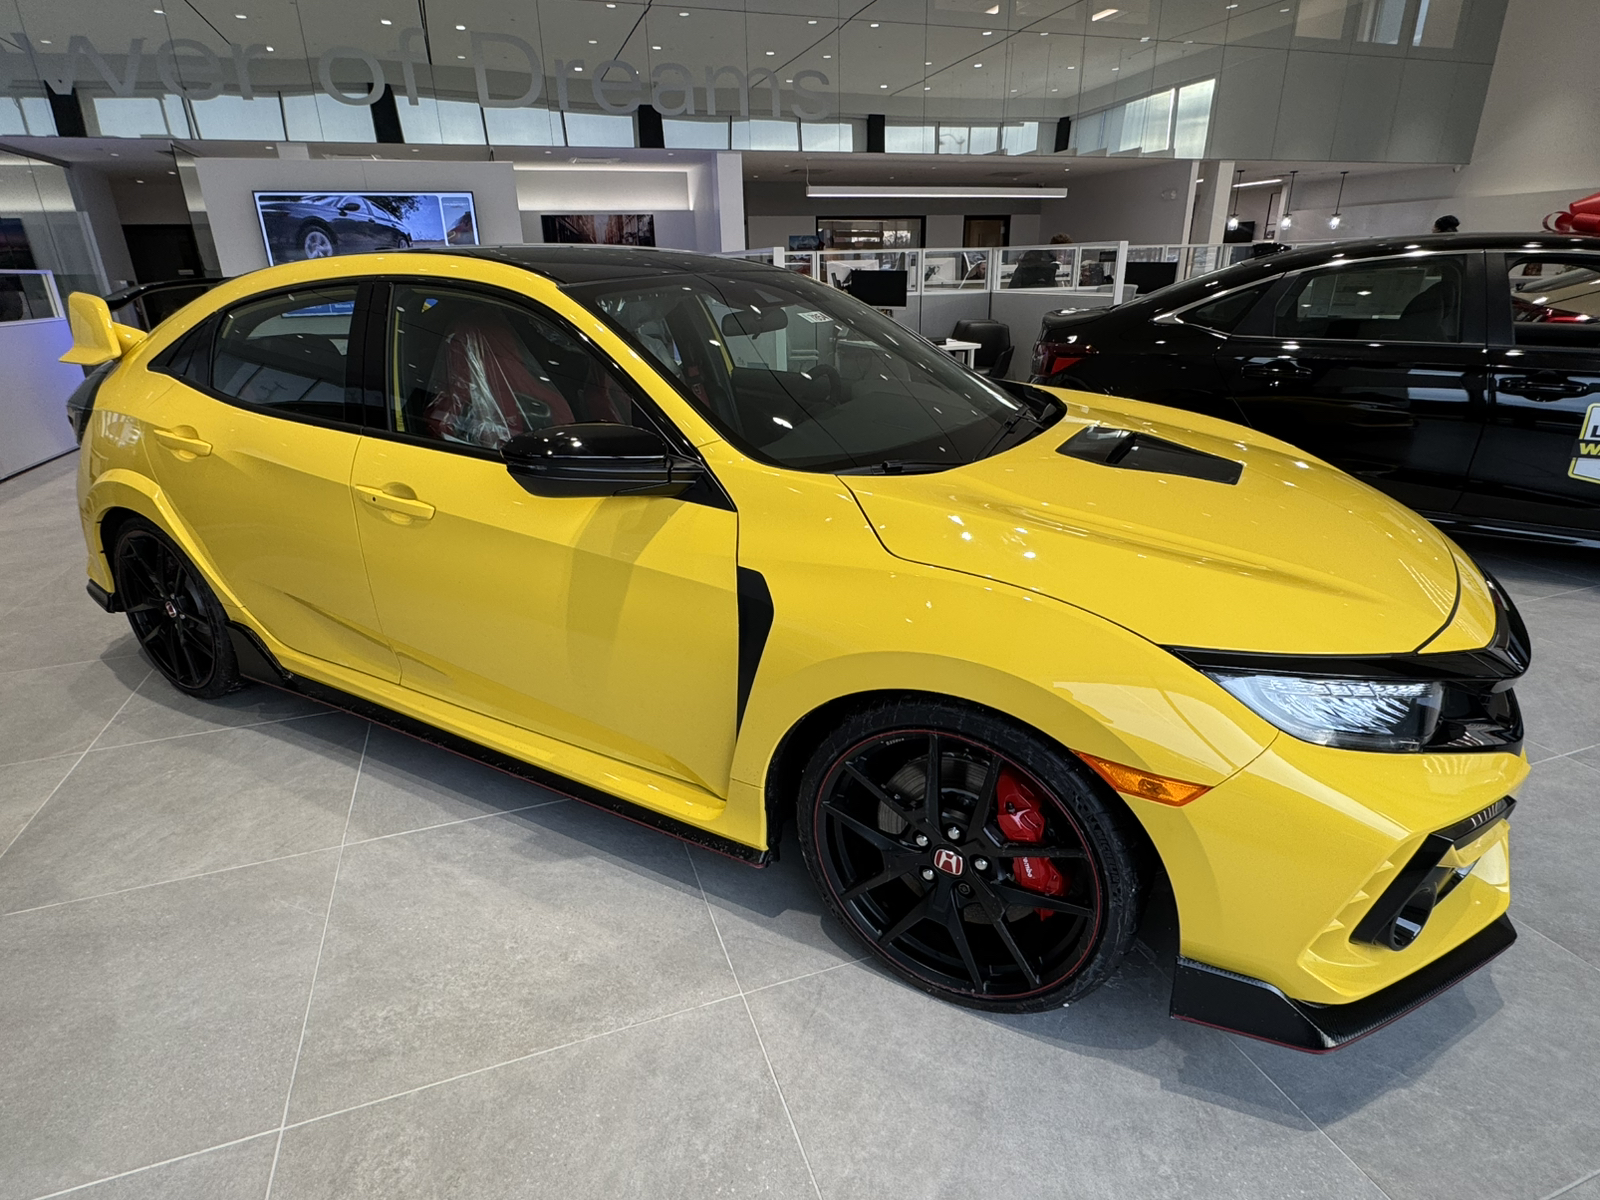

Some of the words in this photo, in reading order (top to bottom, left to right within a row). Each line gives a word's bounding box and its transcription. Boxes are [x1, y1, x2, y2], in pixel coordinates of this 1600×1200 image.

[0, 32, 268, 101] wer
[318, 27, 428, 107] of
[470, 31, 831, 121] Dreams
[1095, 829, 1121, 885] MICHELIN
